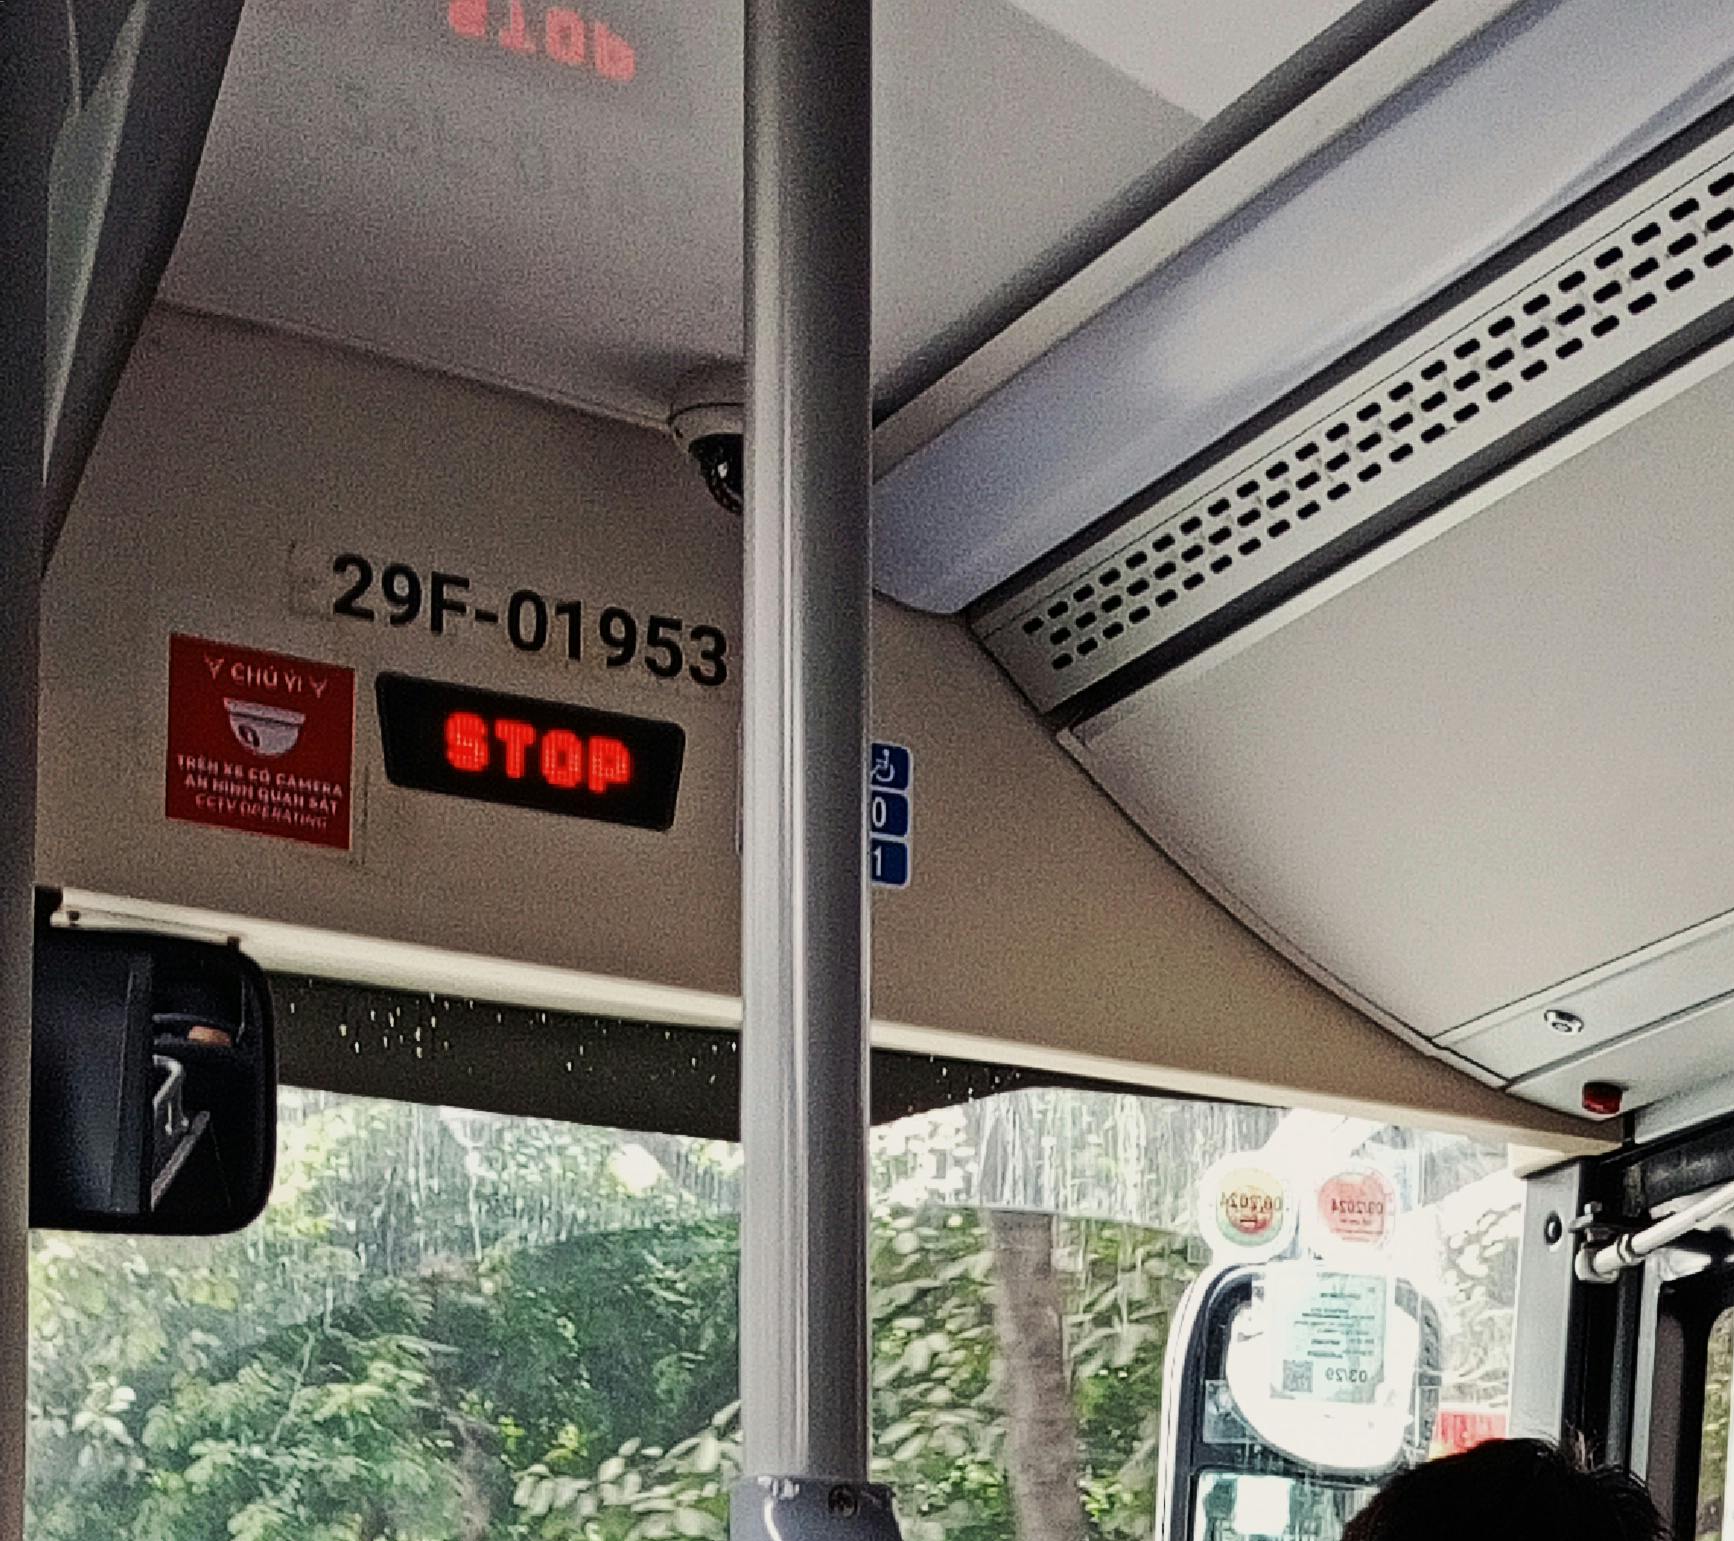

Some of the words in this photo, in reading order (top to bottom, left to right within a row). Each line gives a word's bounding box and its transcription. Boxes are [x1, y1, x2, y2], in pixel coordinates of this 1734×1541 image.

[333, 552, 728, 687] 29F-01953
[275, 773, 342, 798] CAMERA
[443, 710, 633, 794] STOP
